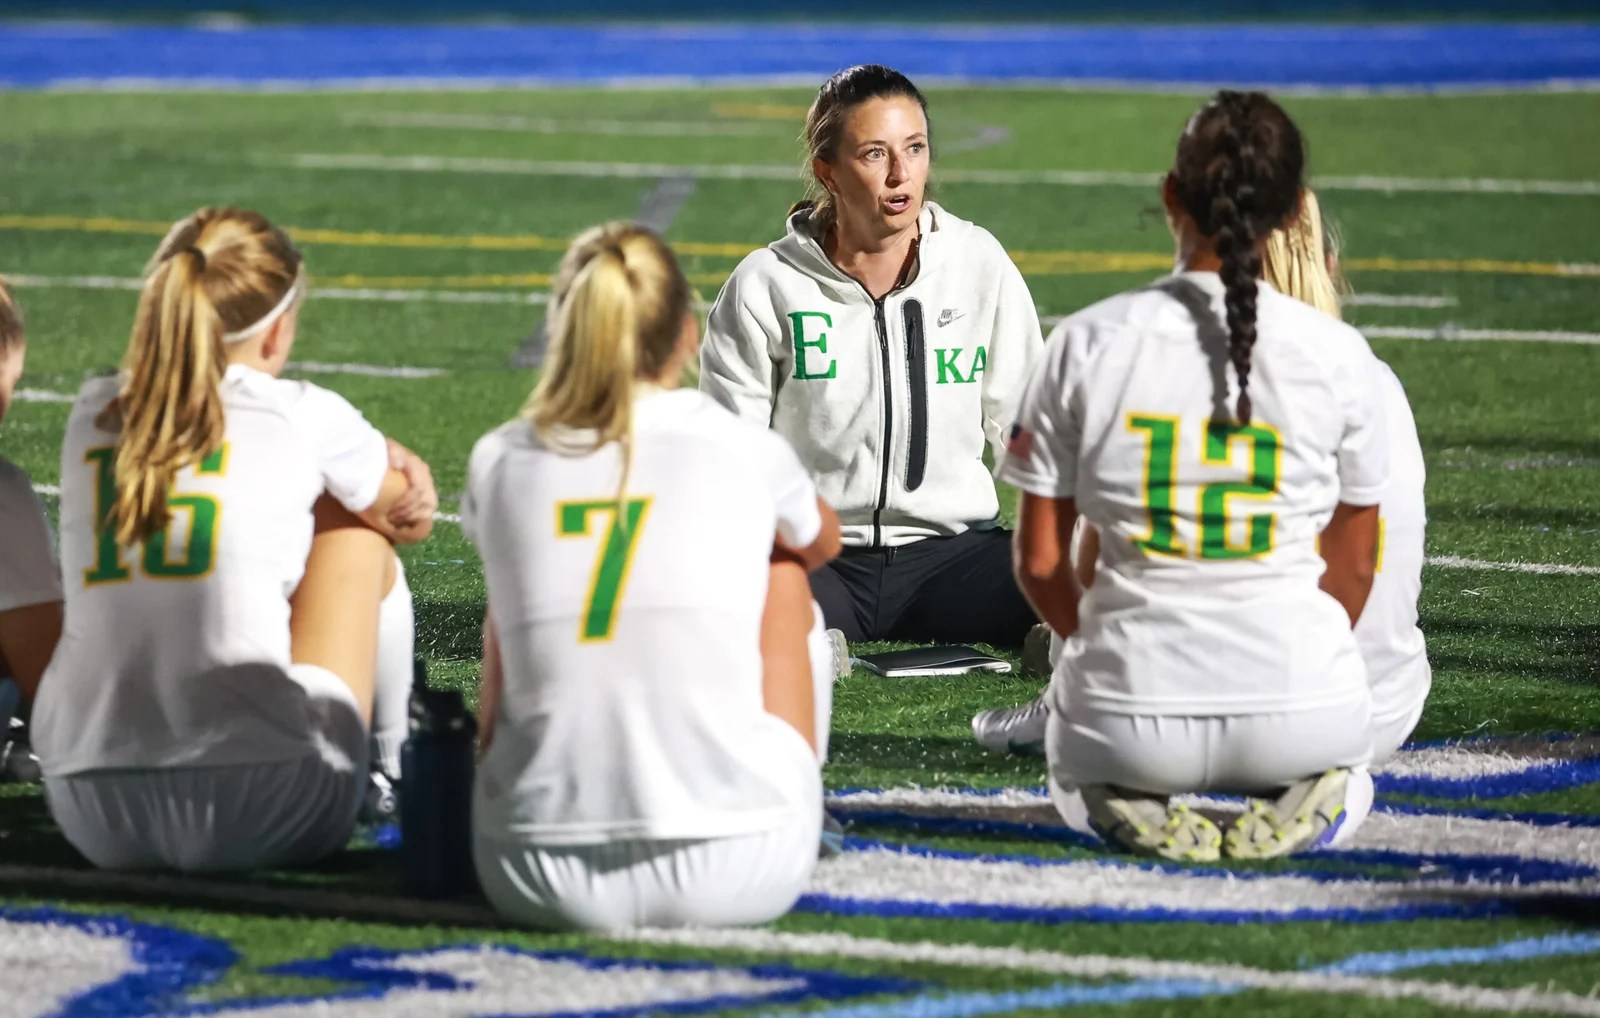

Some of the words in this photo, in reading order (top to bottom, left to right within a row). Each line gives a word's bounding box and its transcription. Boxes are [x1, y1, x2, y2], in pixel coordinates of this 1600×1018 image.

[787, 311, 837, 379] E
[934, 346, 986, 384] KA
[83, 441, 230, 590] 16
[1125, 412, 1283, 561] 12
[555, 496, 654, 645] 7
